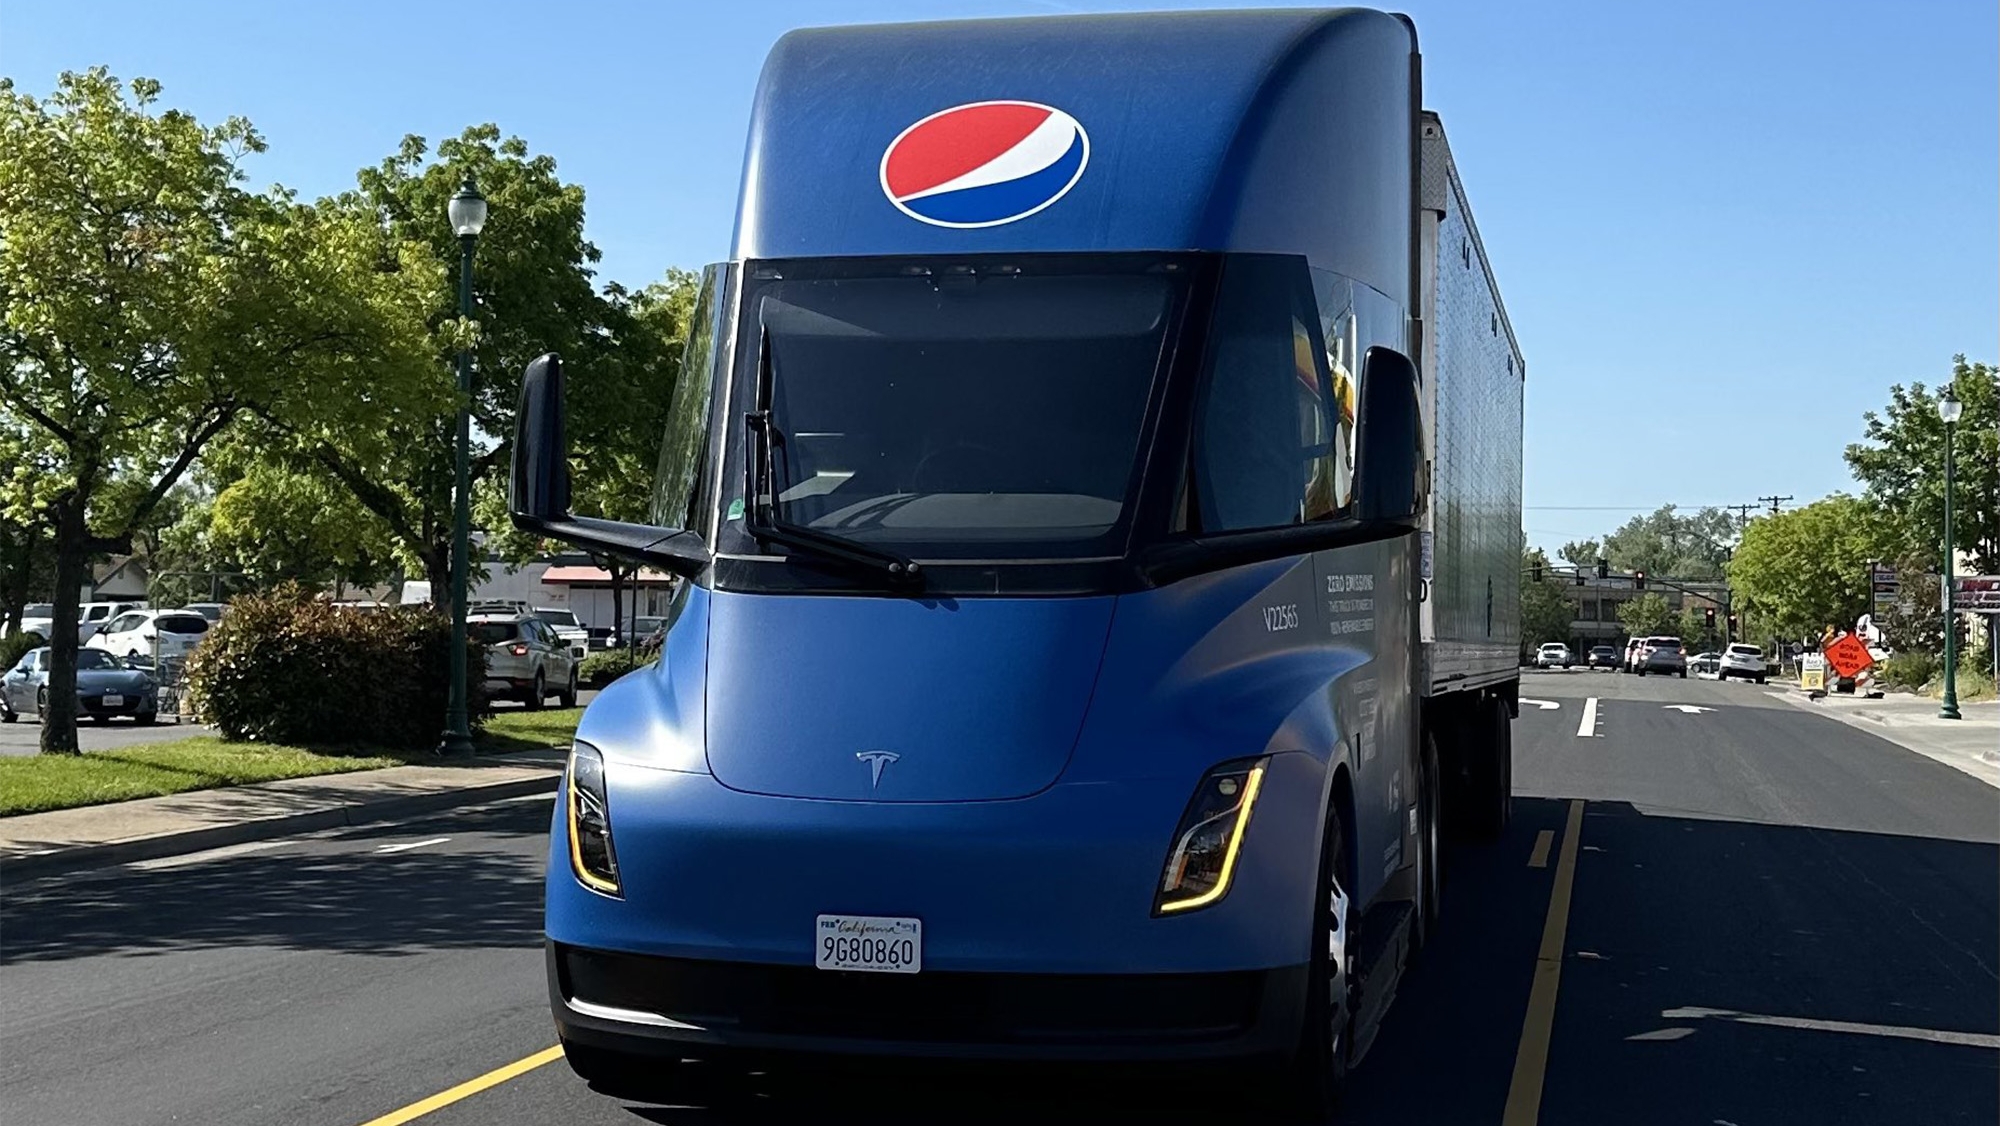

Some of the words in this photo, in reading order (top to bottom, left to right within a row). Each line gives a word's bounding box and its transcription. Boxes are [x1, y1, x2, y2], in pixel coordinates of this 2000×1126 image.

[1327, 574, 1345, 593] ZERO
[1262, 603, 1299, 632] V22565
[838, 920, 901, 937] California
[823, 936, 914, 965] 9G80860
